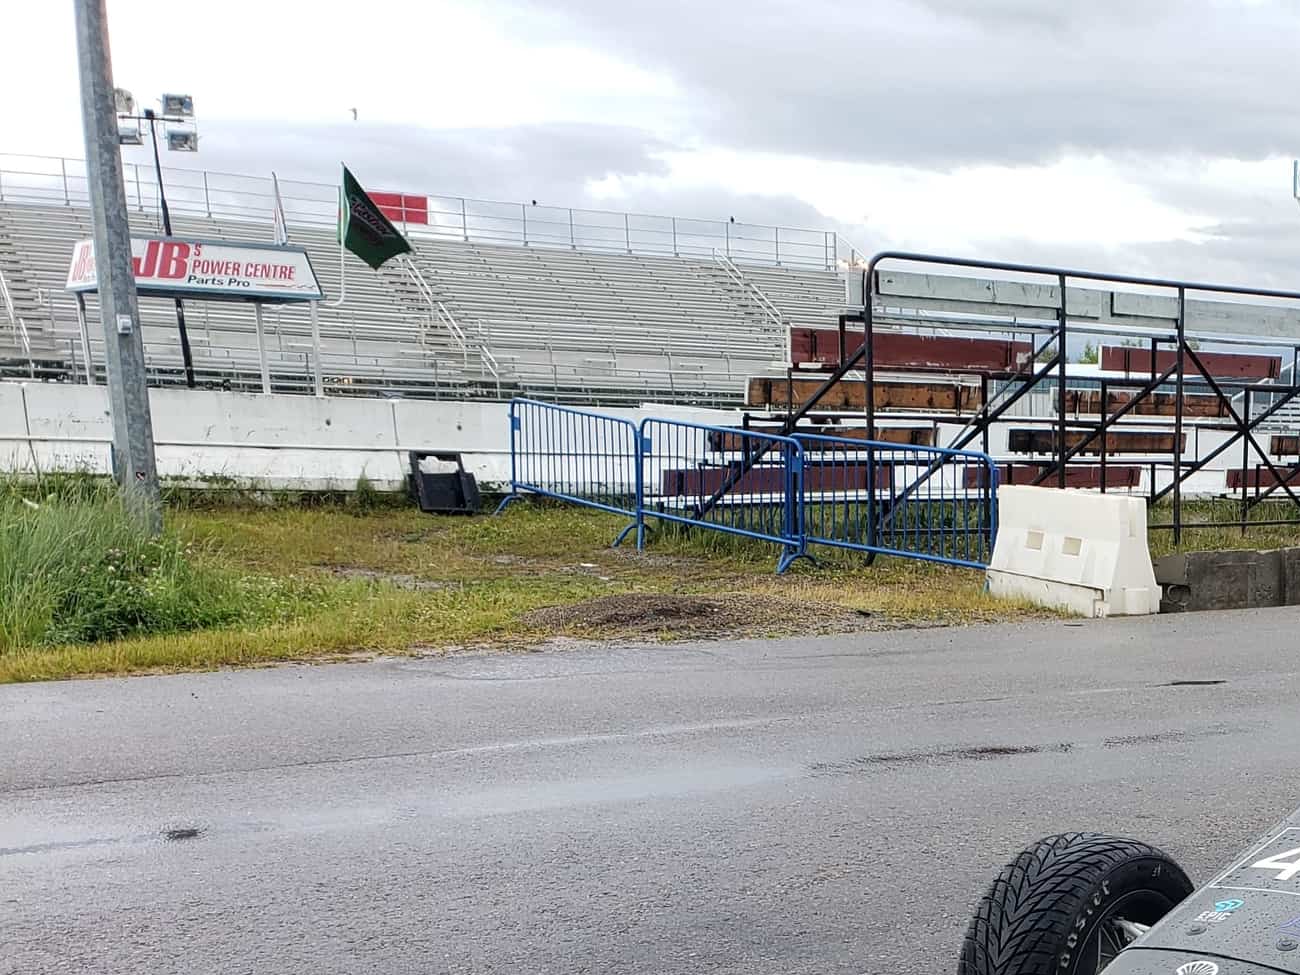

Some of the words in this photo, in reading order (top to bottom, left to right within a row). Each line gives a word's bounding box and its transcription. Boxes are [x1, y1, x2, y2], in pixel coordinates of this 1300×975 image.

[192, 259, 242, 277] POWER
[245, 262, 296, 281] CENTRE
[187, 274, 224, 287] Parts
[228, 276, 251, 288] Pro
[1194, 910, 1233, 922] EPIC
